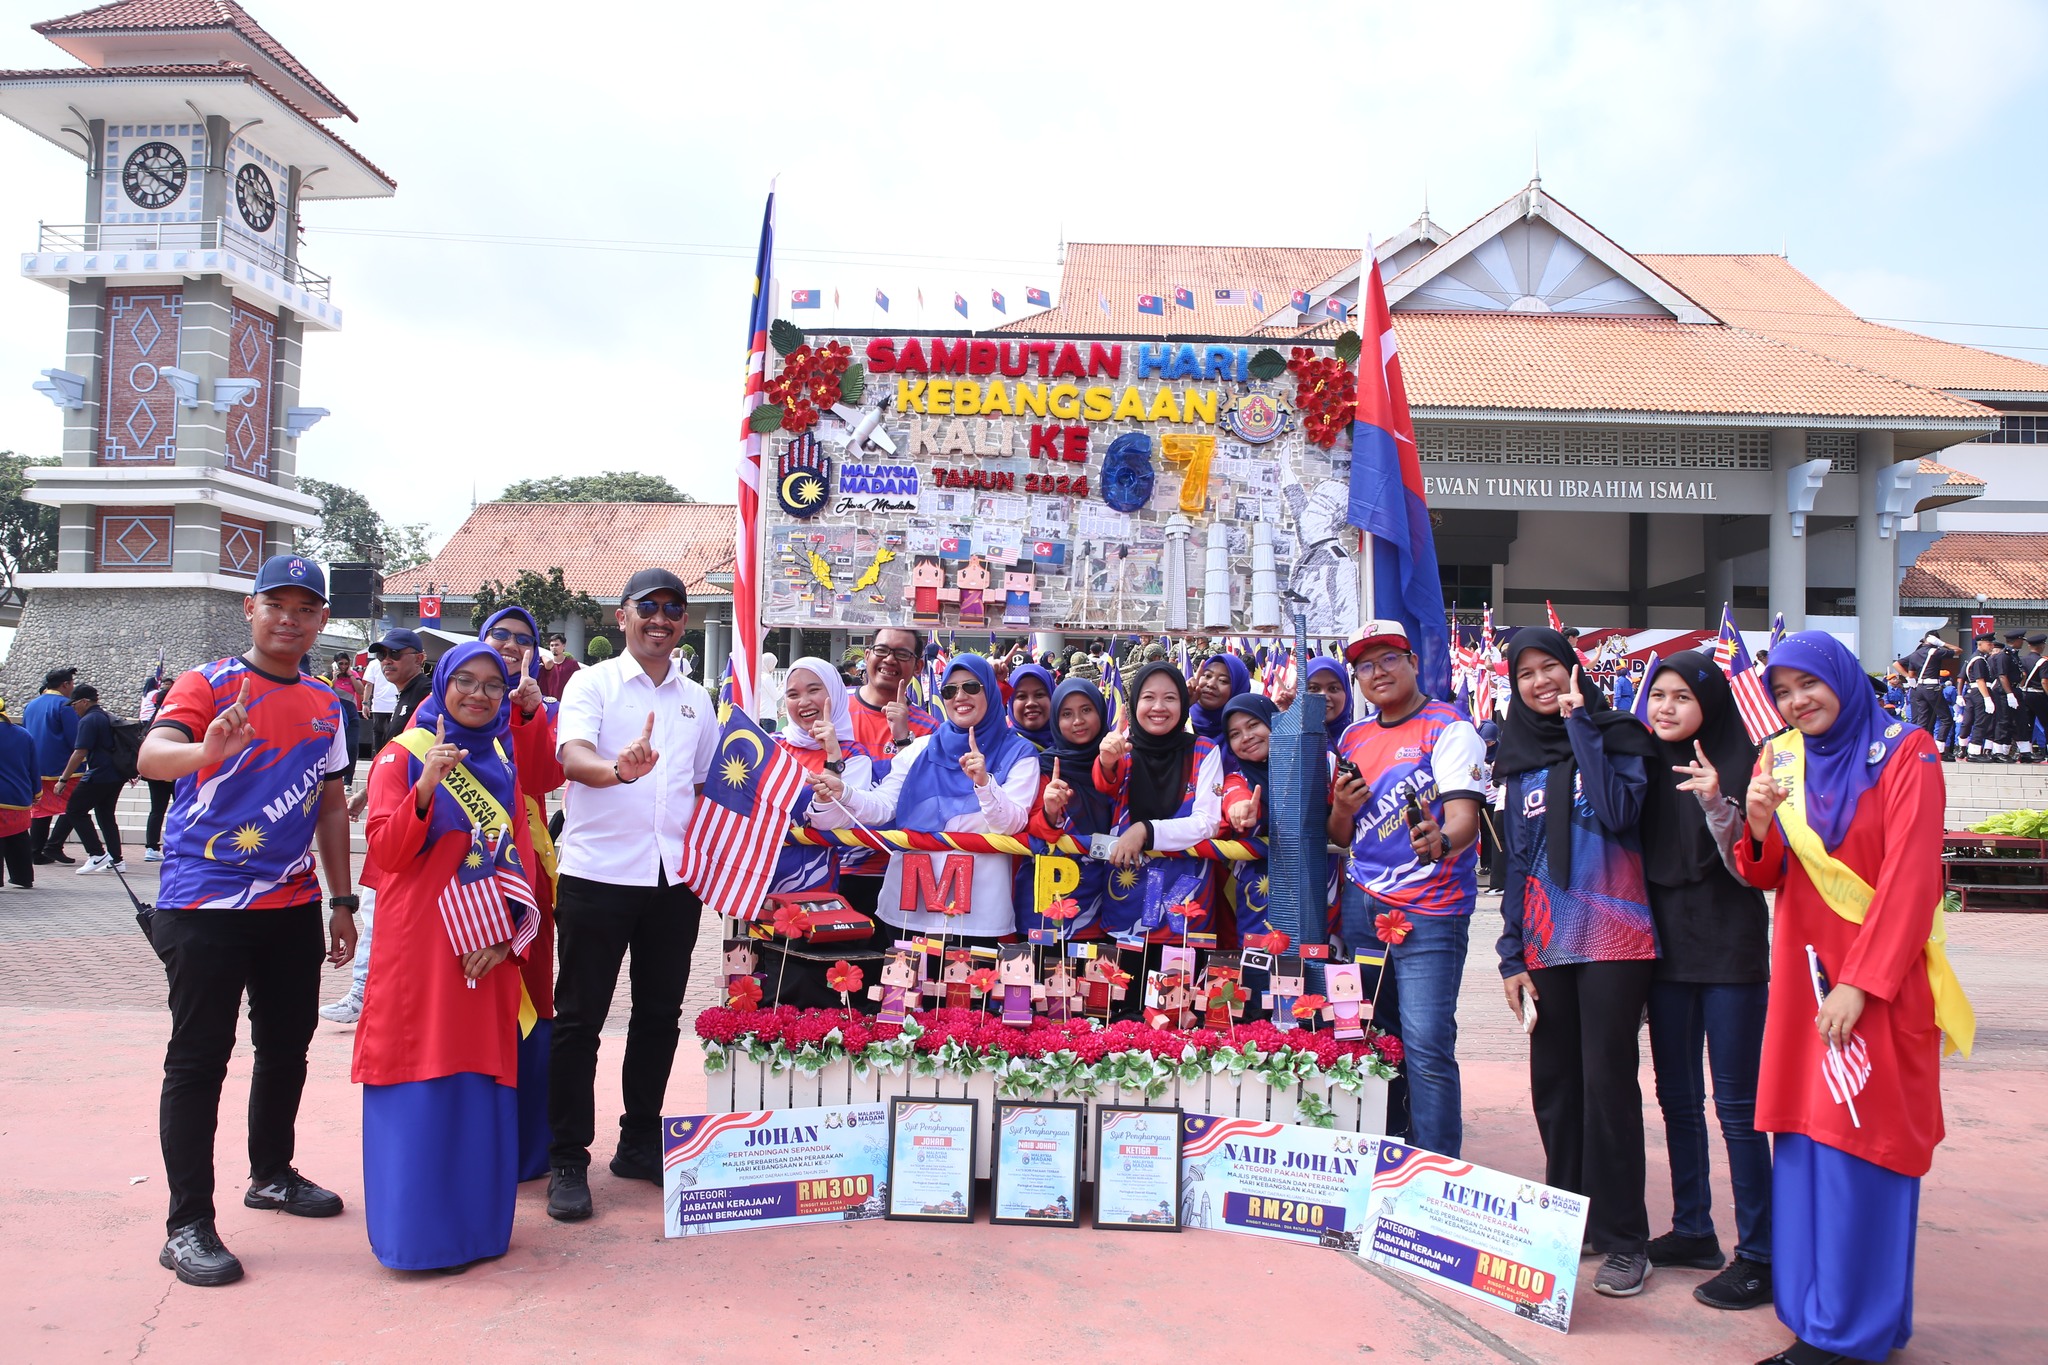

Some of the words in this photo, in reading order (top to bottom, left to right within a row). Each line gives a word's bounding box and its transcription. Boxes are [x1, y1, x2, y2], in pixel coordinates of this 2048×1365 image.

[866, 337, 1122, 379] SAMBUTAN
[1137, 343, 1249, 383] HARI
[897, 379, 1217, 424] KEBANGSAAN
[908, 420, 1015, 457] KALI
[1029, 423, 1089, 462] KE
[841, 464, 918, 478] MALAYSIA
[1101, 432, 1215, 512] 67
[839, 477, 918, 495] MADANI
[932, 467, 1014, 491] TAHUN
[1024, 473, 1090, 498] 2024
[1424, 476, 1479, 496] EWAN
[1485, 478, 1553, 497] TUNKU
[1559, 479, 1643, 499] IBRAHIM
[1649, 481, 1717, 501] ISMAIL
[836, 497, 865, 513] Jiwa
[865, 498, 916, 512] Merdeka
[262, 752, 330, 824] MALAYSI
[451, 767, 497, 821] MALAYSIA
[445, 771, 492, 828] MADANI
[1522, 788, 1545, 816] JO
[900, 853, 974, 913] M
[1034, 853, 1080, 914] P
[1141, 867, 1201, 934] K
[858, 1114, 885, 1122] MADANI
[919, 1123, 965, 1133] Penghargaan
[744, 1125, 819, 1147] JOHAN
[920, 1137, 945, 1146] JOHAN
[1024, 1126, 1070, 1137] Penghargaan
[1125, 1131, 1171, 1142] Penghargaan
[728, 1147, 789, 1159] PERTANDINGAN
[791, 1144, 832, 1154] SEPANDUK
[1018, 1141, 1034, 1149] NAIB
[1035, 1142, 1056, 1150] JOHAN
[1125, 1146, 1151, 1155] KETIGA
[722, 1160, 746, 1168] MAJLIS
[747, 1157, 788, 1166] PERBARISAN
[804, 1152, 844, 1161] PERARAKAN
[735, 1165, 752, 1173] HARI
[753, 1163, 798, 1172] KEBANGSAAN
[1223, 1142, 1277, 1166] NAIB
[1282, 1151, 1359, 1176] JOHAN
[1227, 1171, 1250, 1180] MAJLIS
[1251, 1174, 1291, 1184] PERBARISAN
[1292, 1179, 1307, 1187] DAN
[1308, 1182, 1349, 1193] PERARAKAN
[1233, 1163, 1272, 1174] KATEGORI
[1274, 1169, 1310, 1179] PAKAIAN
[1312, 1173, 1345, 1183] TERBAIK
[682, 1189, 727, 1201] KATEGORI
[798, 1176, 868, 1201] RM300
[1239, 1179, 1255, 1187] HARI
[1256, 1181, 1300, 1192] KEBANGSAAN
[1301, 1187, 1317, 1195] KALI
[683, 1201, 724, 1212] JABATAN
[726, 1196, 775, 1208] KERAJAAN
[1248, 1196, 1324, 1227] RM200
[1442, 1181, 1518, 1221] KETIGA
[1552, 1199, 1581, 1213] MADANI
[683, 1212, 713, 1222] BADAN
[715, 1208, 762, 1219] BERKANUN
[1419, 1204, 1439, 1216] MAJLIS
[1440, 1209, 1478, 1228] PERBARISAN
[1479, 1223, 1492, 1233] DAN
[1493, 1228, 1533, 1246] PERARAKAN
[1426, 1196, 1481, 1219] PERTANDINGAN
[1482, 1214, 1530, 1235] PERARAKAN
[1378, 1218, 1417, 1239] KATEGORI
[1429, 1215, 1444, 1224] HARI
[1444, 1220, 1485, 1238] KEBANGSAAN
[1486, 1232, 1501, 1243] KALI
[1374, 1240, 1400, 1256] BADAN
[1399, 1249, 1441, 1271] BERKANUN
[1375, 1231, 1411, 1249] JABATAN
[1411, 1242, 1455, 1265] KERAJAAN
[1477, 1252, 1545, 1295] RM100
